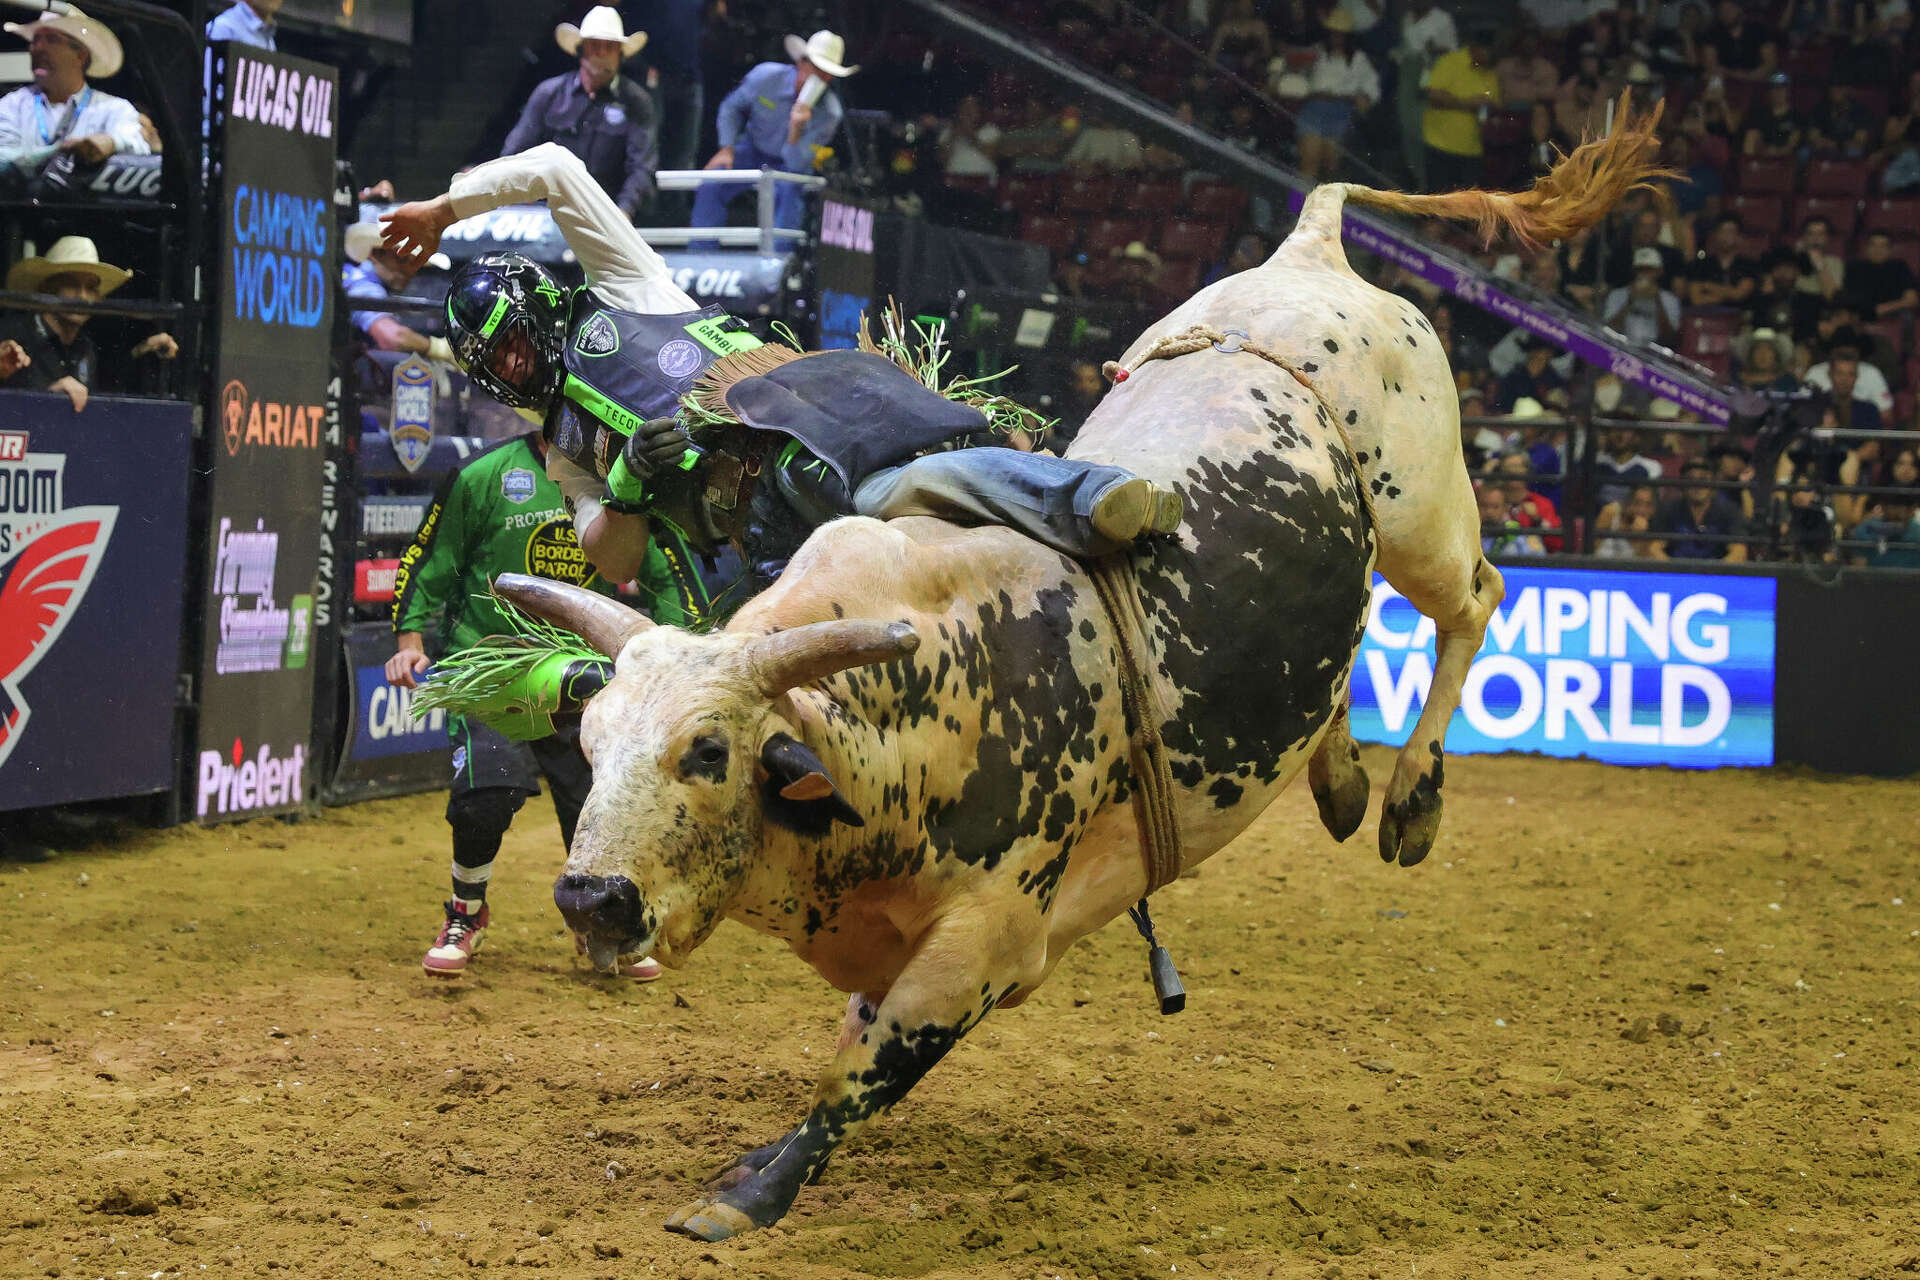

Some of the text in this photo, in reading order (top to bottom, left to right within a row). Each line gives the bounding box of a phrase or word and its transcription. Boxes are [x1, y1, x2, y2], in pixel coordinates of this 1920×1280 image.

[232, 57, 300, 132] LUCAS
[302, 75, 333, 139] OIL
[233, 184, 326, 254] CAMPING
[233, 246, 325, 328] WORLD
[695, 268, 744, 297] OIL
[489, 310, 502, 328] YETI
[245, 405, 324, 448] ARIAT
[504, 507, 567, 531] PROTEC
[535, 544, 588, 562] BORDE
[1364, 649, 1733, 747] WORLD
[197, 738, 305, 816] Priefert
